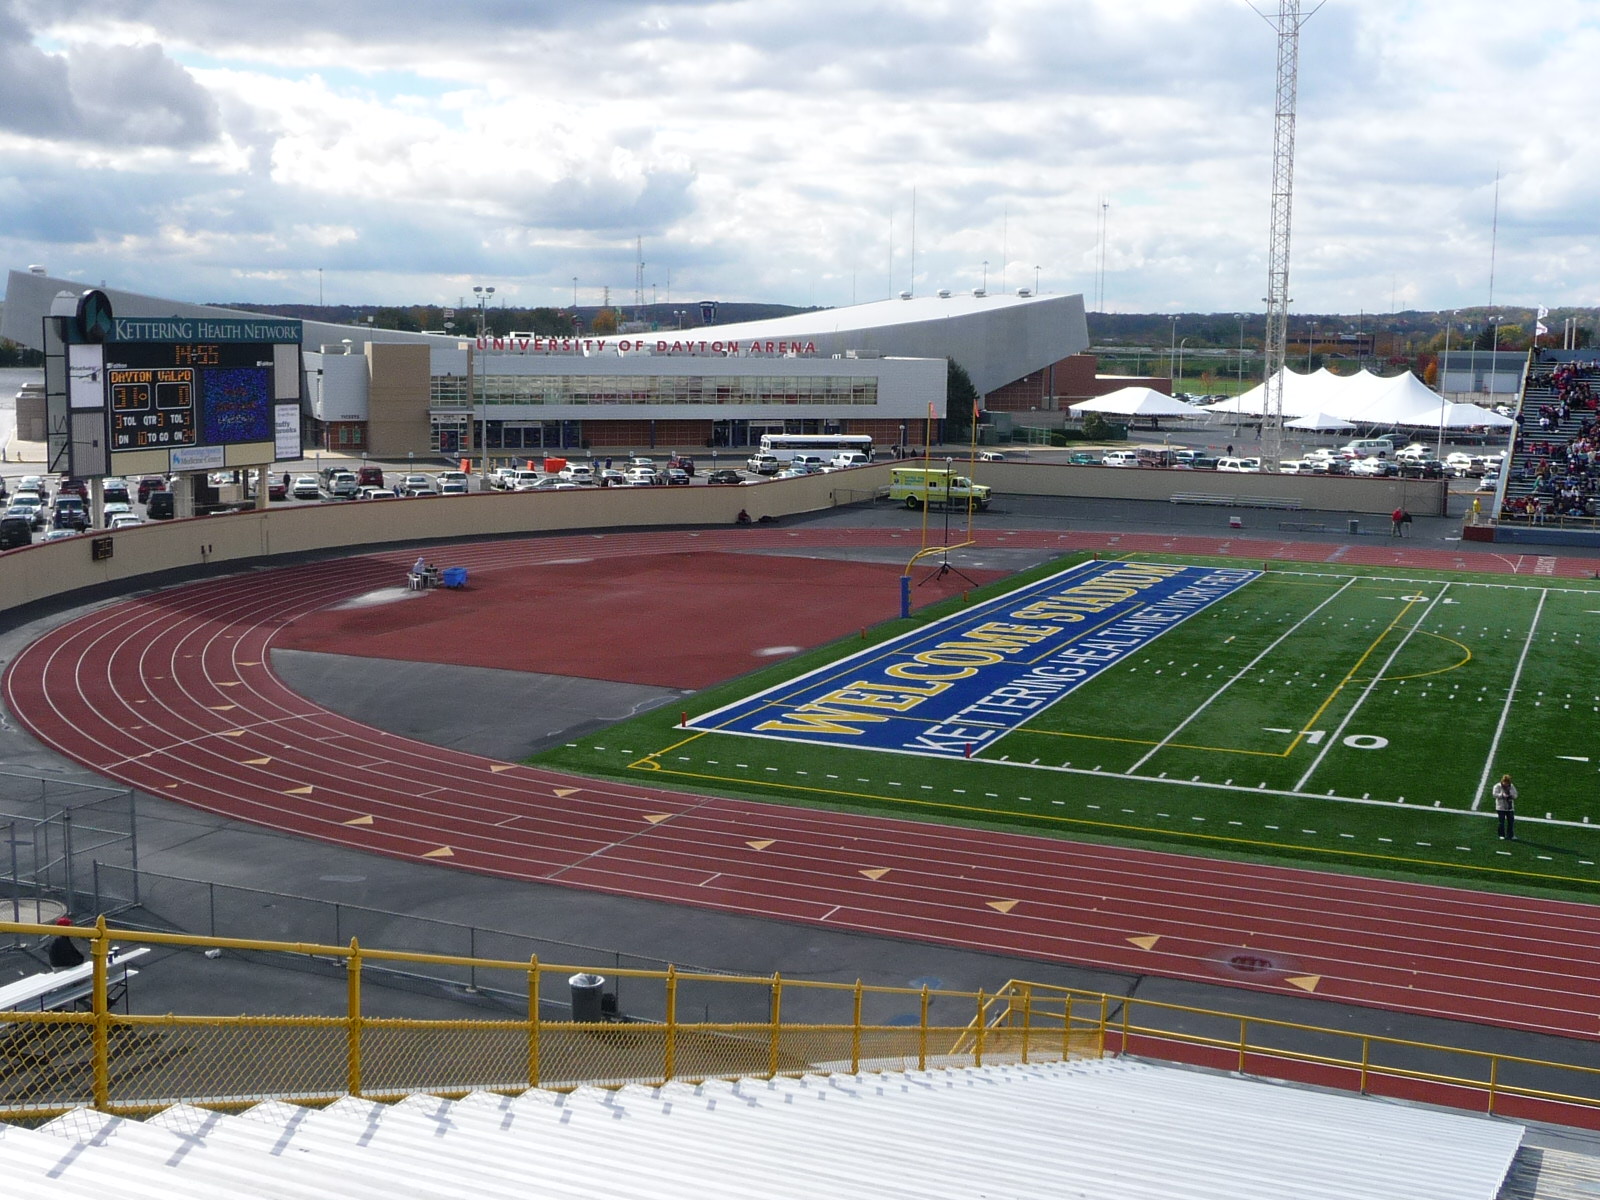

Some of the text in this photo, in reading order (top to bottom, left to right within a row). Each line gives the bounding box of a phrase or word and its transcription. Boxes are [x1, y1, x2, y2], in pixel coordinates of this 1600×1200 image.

[115, 319, 298, 340] KETTERING HEALTH NETWORK
[476, 338, 816, 353] UNIVERSITY OF DAYTON ARENA
[111, 371, 152, 383] DAYTON
[123, 416, 137, 426] TOL
[143, 415, 157, 426] QTR
[170, 414, 183, 424] TOL
[147, 432, 157, 442] TO
[159, 432, 169, 442] GO
[174, 431, 183, 440] ON
[751, 563, 1188, 735] WELCOME STADIUM
[902, 569, 1254, 753] KETTERING HEALTH NETWORK FIELD
